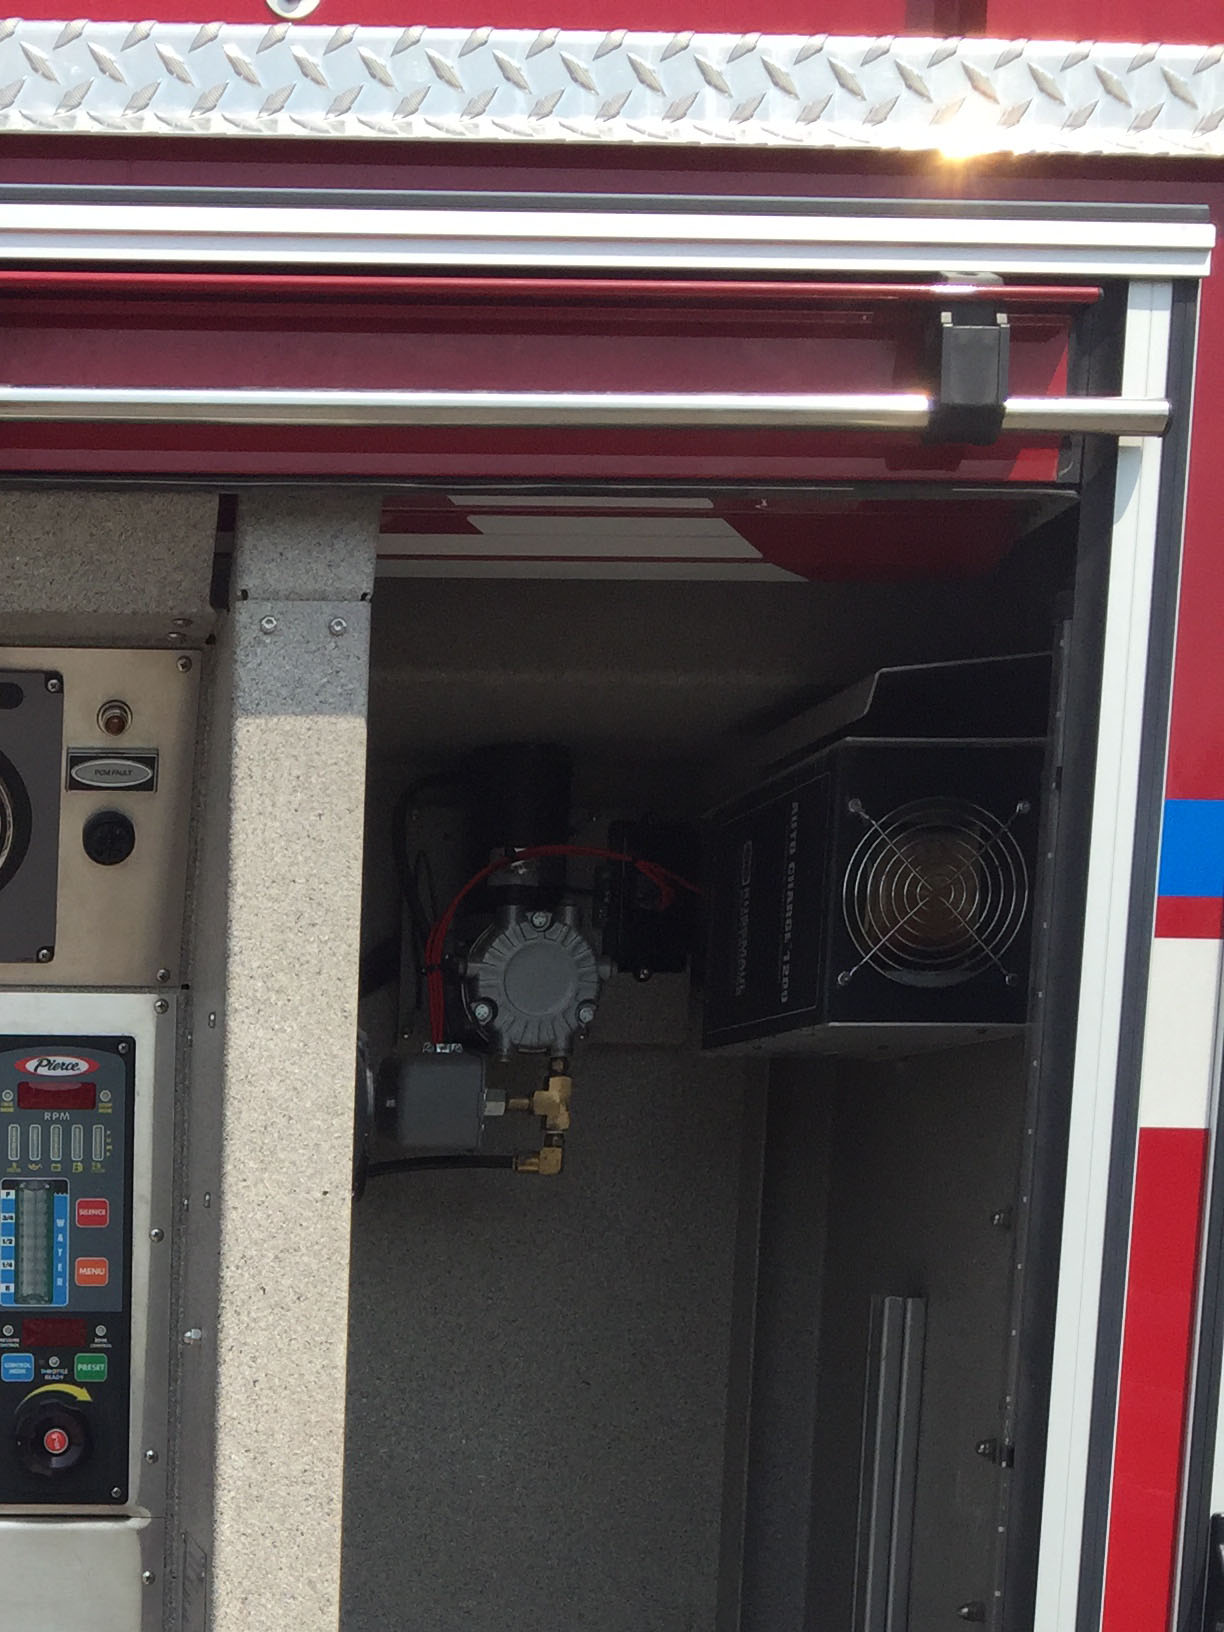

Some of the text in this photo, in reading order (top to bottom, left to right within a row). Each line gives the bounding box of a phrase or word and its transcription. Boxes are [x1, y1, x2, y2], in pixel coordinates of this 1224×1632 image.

[784, 861, 796, 943] CHARGE
[34, 1058, 80, 1072] Pierce
[44, 1112, 70, 1120] RPM
[79, 1267, 105, 1275] MENU
[77, 1364, 105, 1372] PRESET
